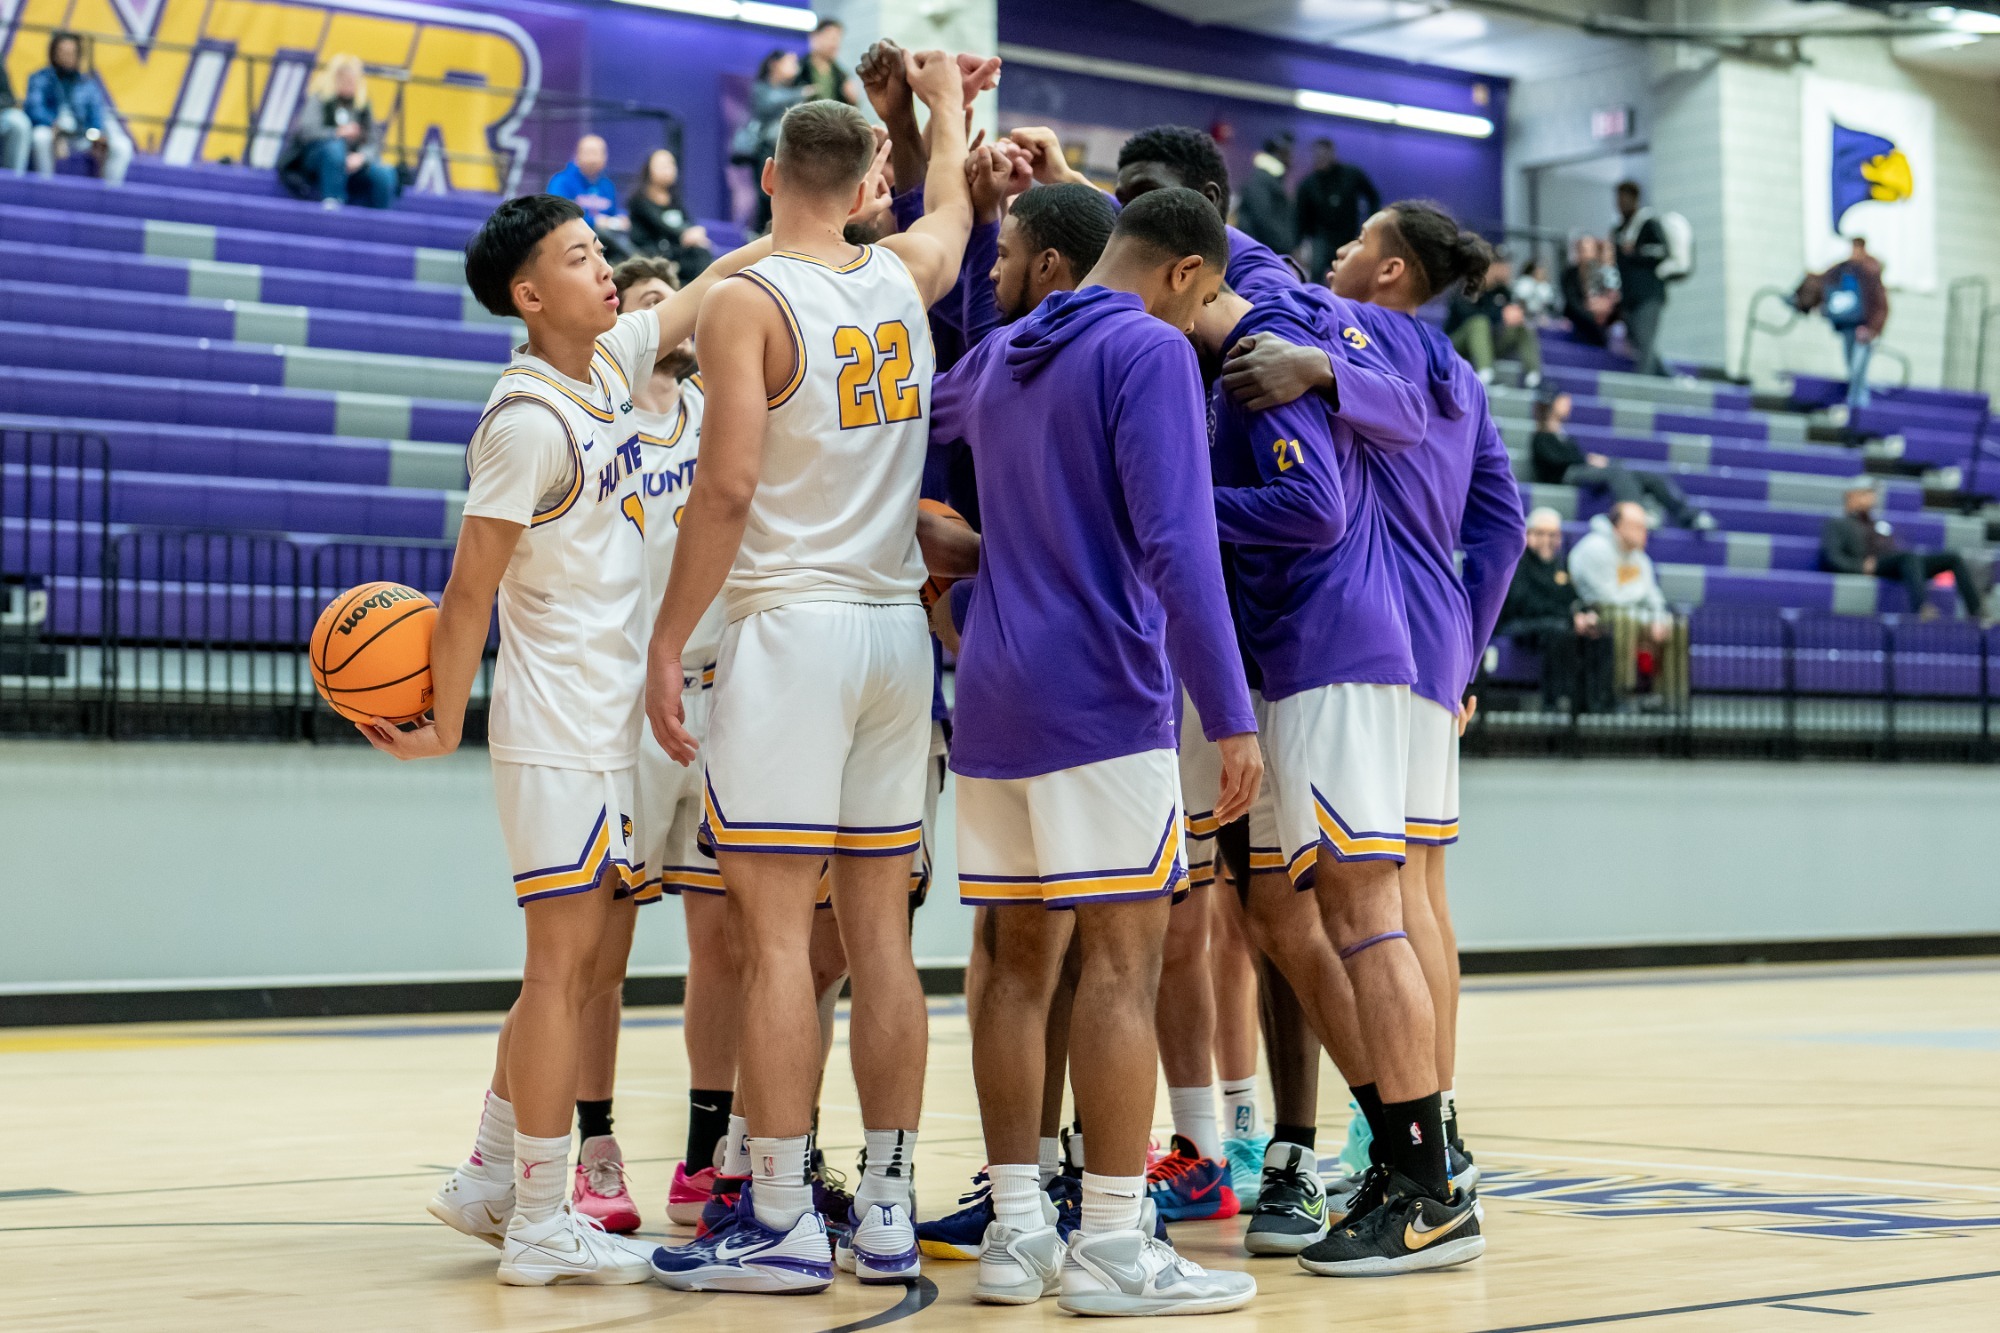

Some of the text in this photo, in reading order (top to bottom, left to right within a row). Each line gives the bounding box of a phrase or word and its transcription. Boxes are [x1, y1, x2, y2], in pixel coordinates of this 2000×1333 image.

[833, 319, 922, 430] 22
[1273, 438, 1304, 472] 21
[642, 458, 698, 499] UNT
[337, 586, 424, 636] Wilson
